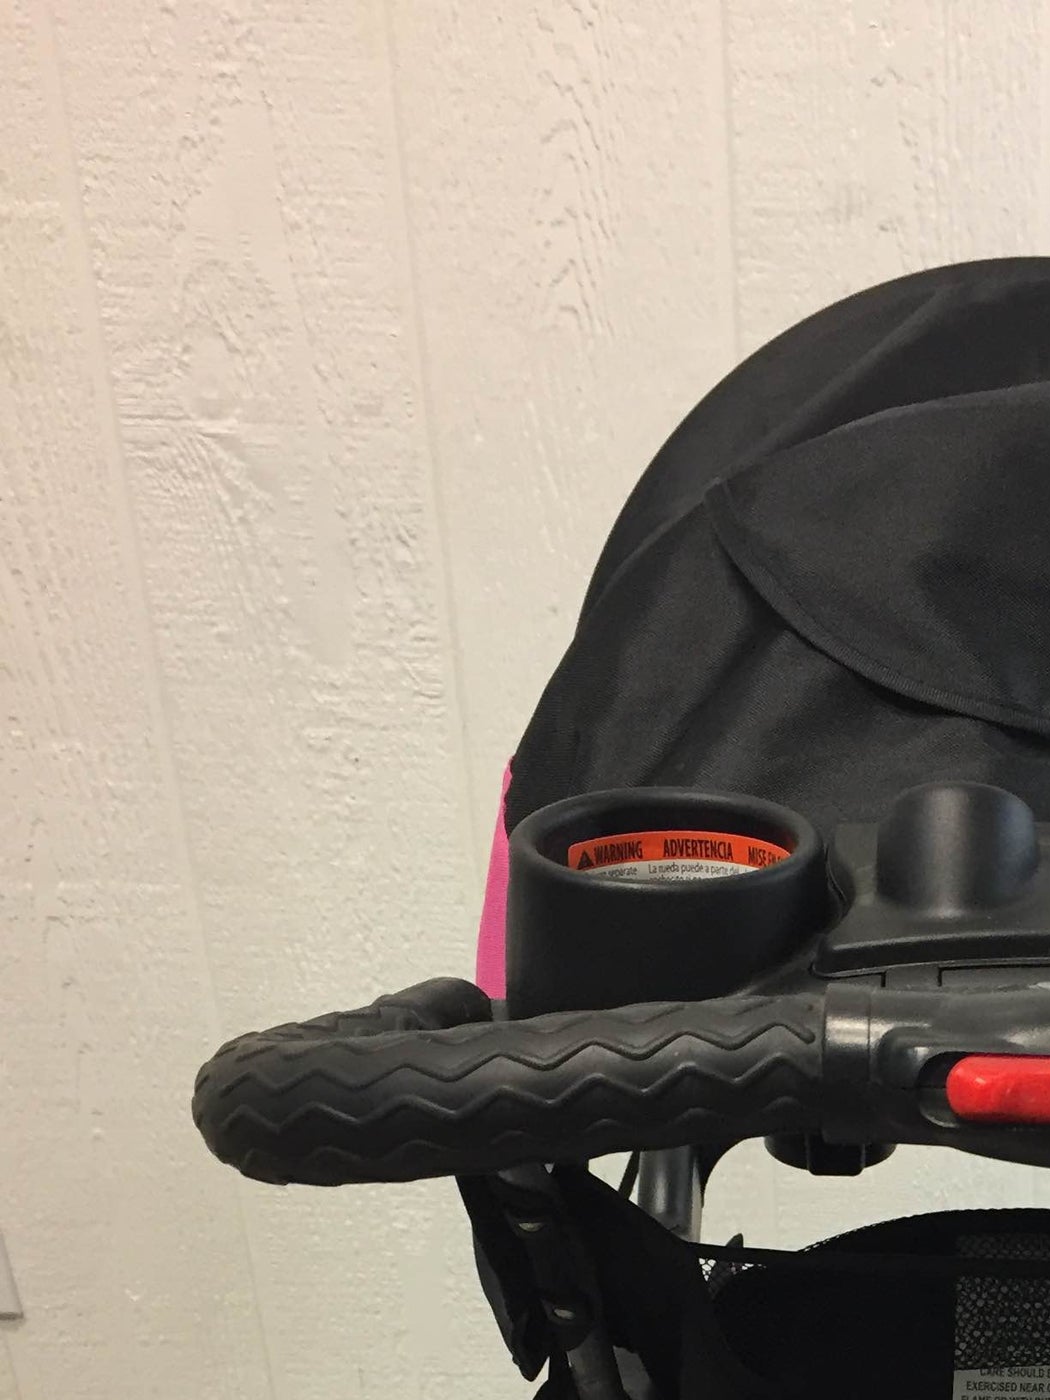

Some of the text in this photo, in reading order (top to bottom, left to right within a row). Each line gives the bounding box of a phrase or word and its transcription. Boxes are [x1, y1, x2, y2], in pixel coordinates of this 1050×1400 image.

[595, 841, 642, 863] WARNING
[663, 839, 733, 860] ADVERTENCIA
[748, 846, 766, 866] MISE
[658, 862, 680, 873] rueda
[681, 863, 704, 875] puede
[1007, 1368, 1045, 1379] SHOULD
[966, 1381, 1017, 1392] EXERCISED
[1020, 1382, 1044, 1393] NEAR
